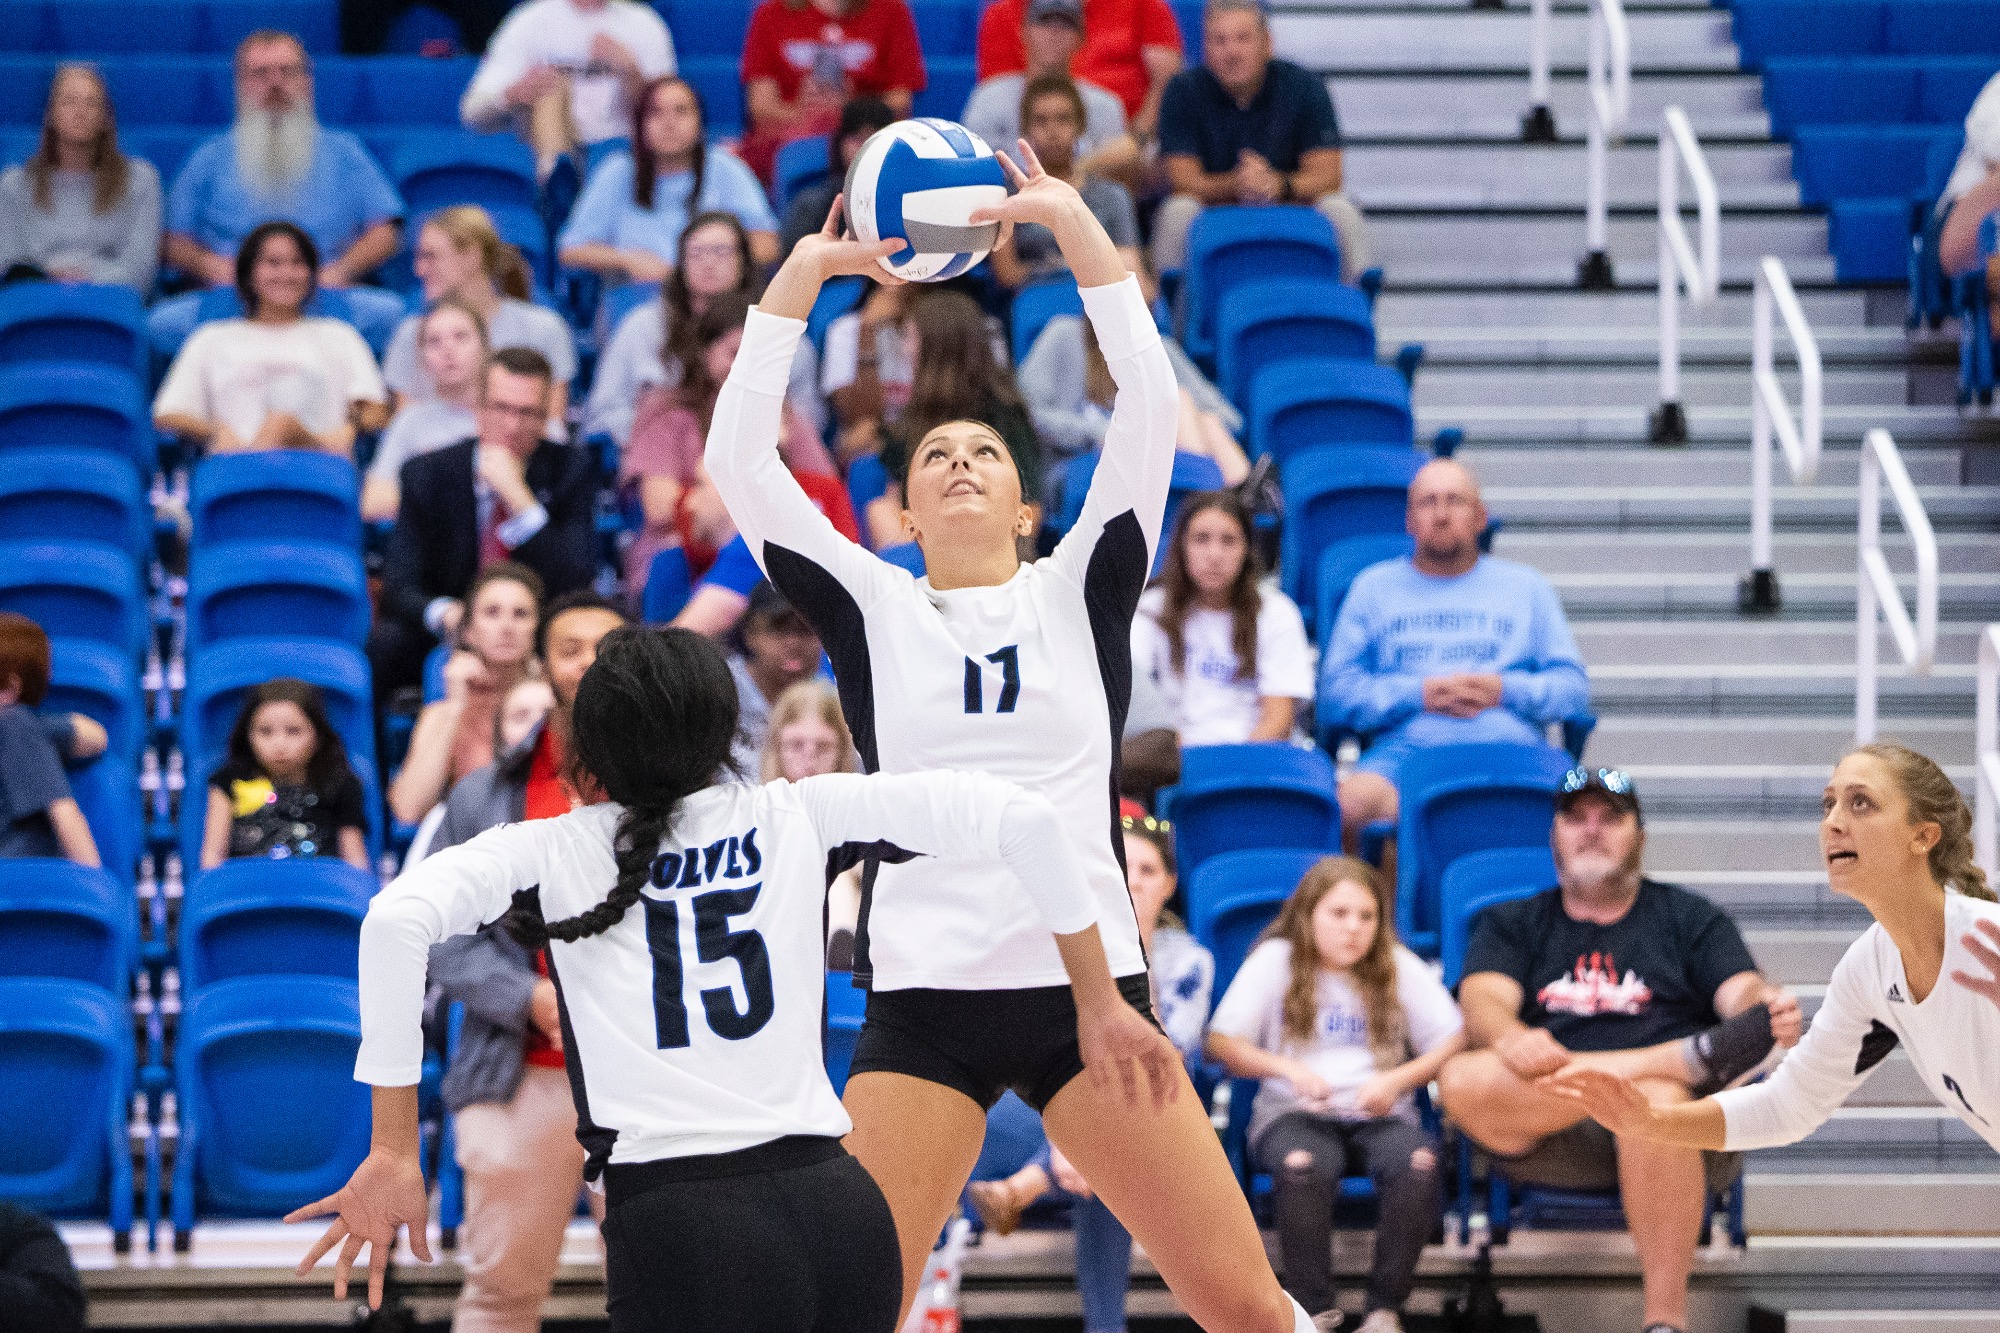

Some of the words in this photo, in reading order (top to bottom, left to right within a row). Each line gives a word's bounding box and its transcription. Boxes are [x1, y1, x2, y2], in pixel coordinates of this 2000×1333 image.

[963, 644, 1021, 714] 17
[650, 827, 762, 890] OLVES
[640, 881, 775, 1049] 15
